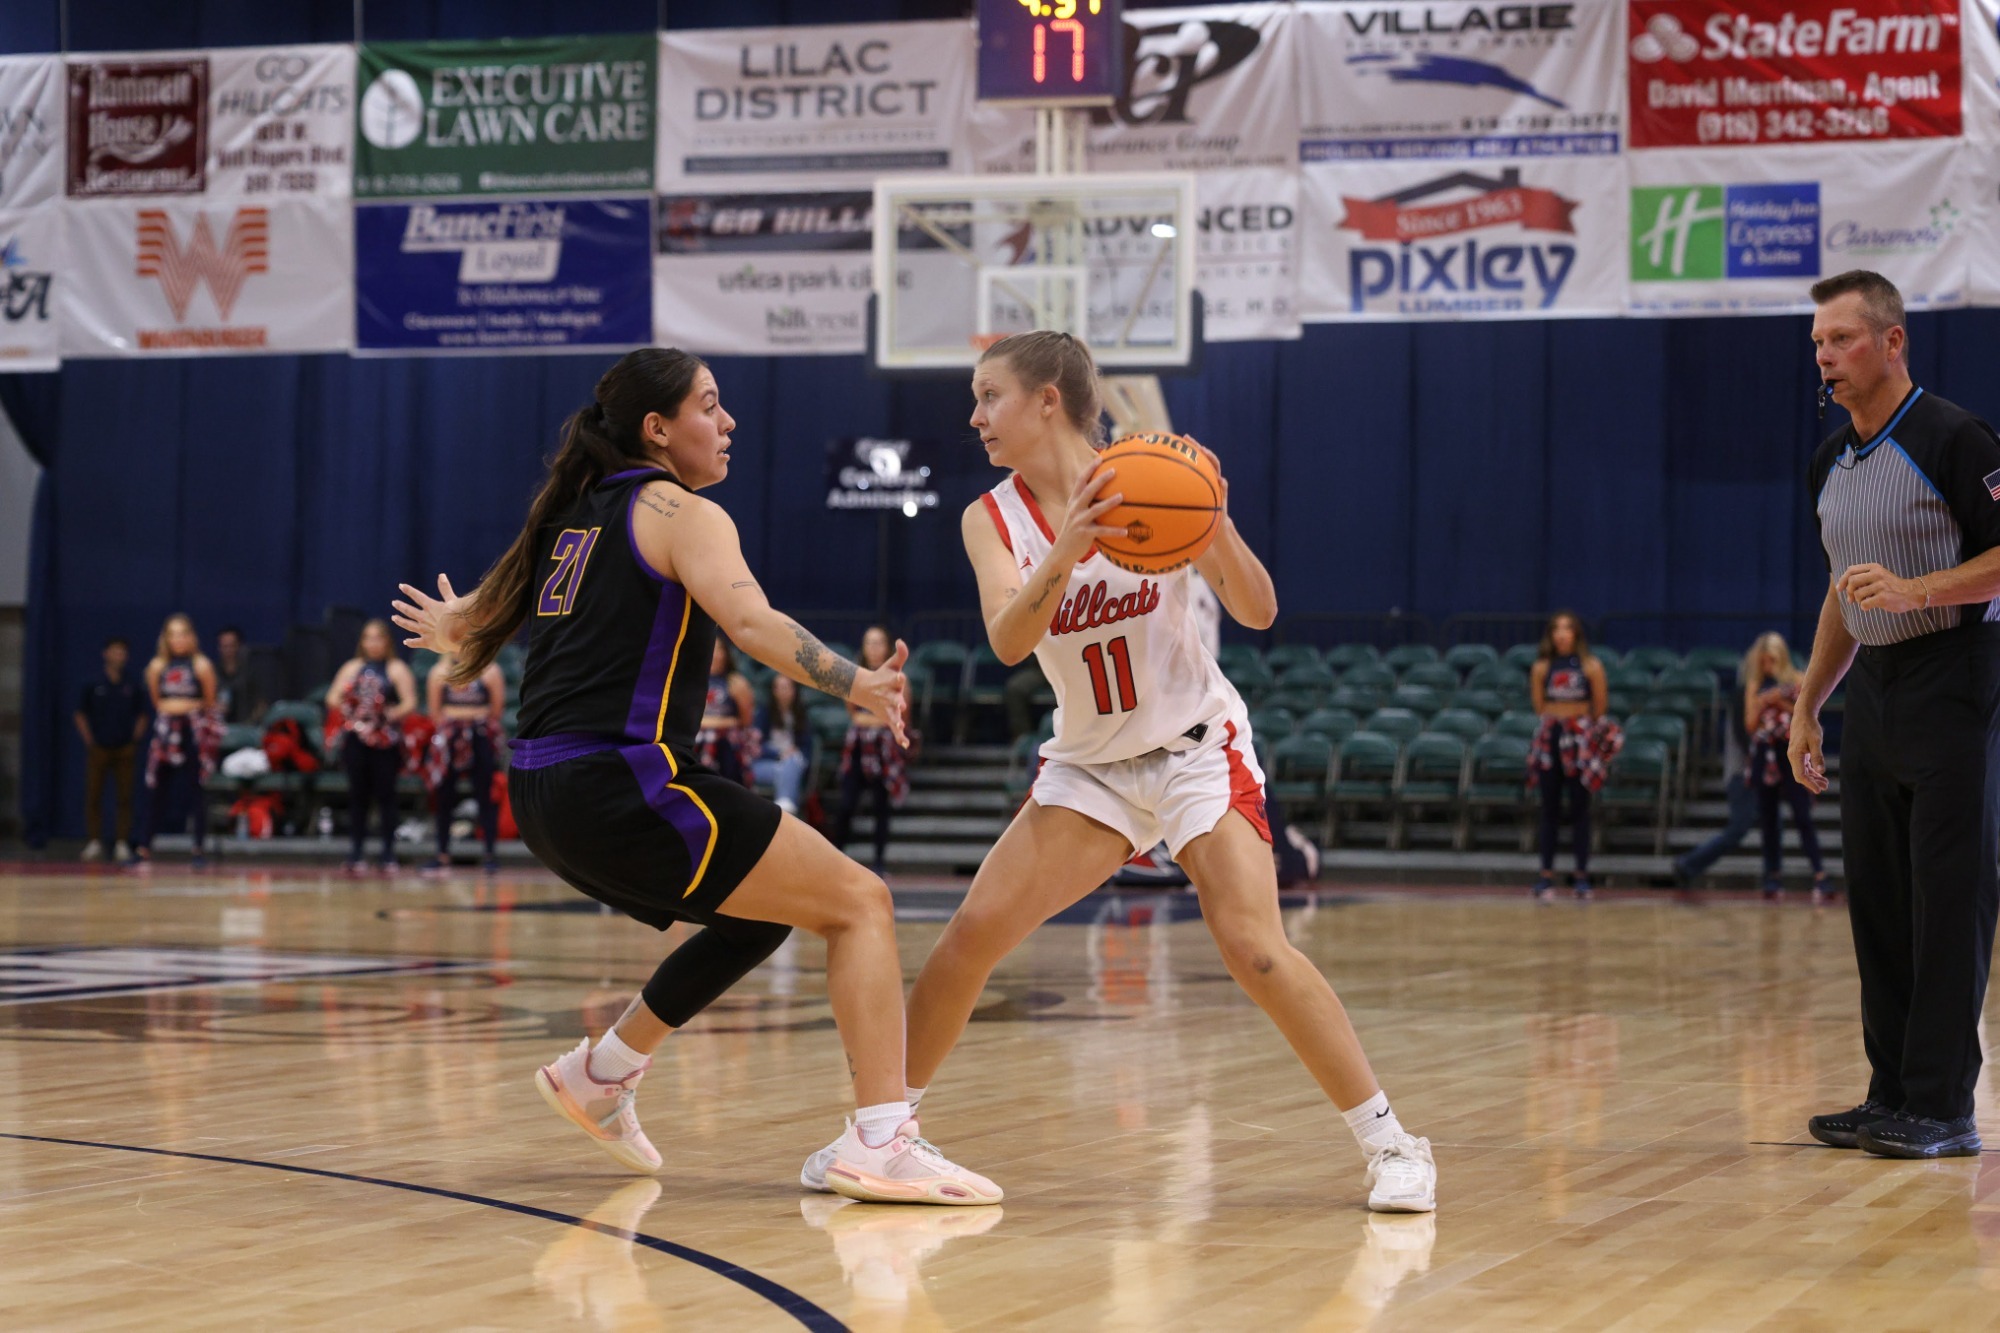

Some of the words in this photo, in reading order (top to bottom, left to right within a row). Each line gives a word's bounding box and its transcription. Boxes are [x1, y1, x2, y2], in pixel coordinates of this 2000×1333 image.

[1344, 5, 1575, 35] VILLAGE
[256, 54, 310, 83] GO
[740, 41, 890, 79] LILAC
[1033, 19, 1085, 83] 17
[431, 61, 646, 106] EXECUTIVE
[695, 81, 937, 121] DISTRICT
[1649, 78, 1718, 108] David
[1863, 71, 1940, 106] Agent
[425, 106, 537, 148] LAWN
[543, 101, 646, 144] CARE
[711, 208, 763, 234] GO
[1397, 206, 1460, 236] Since
[1730, 220, 1815, 247] Express
[1757, 249, 1801, 265] Suites
[717, 268, 783, 293] utica
[787, 268, 842, 297] park
[1350, 240, 1578, 312] pixley
[537, 526, 602, 617] 21
[1082, 635, 1138, 716] 11
